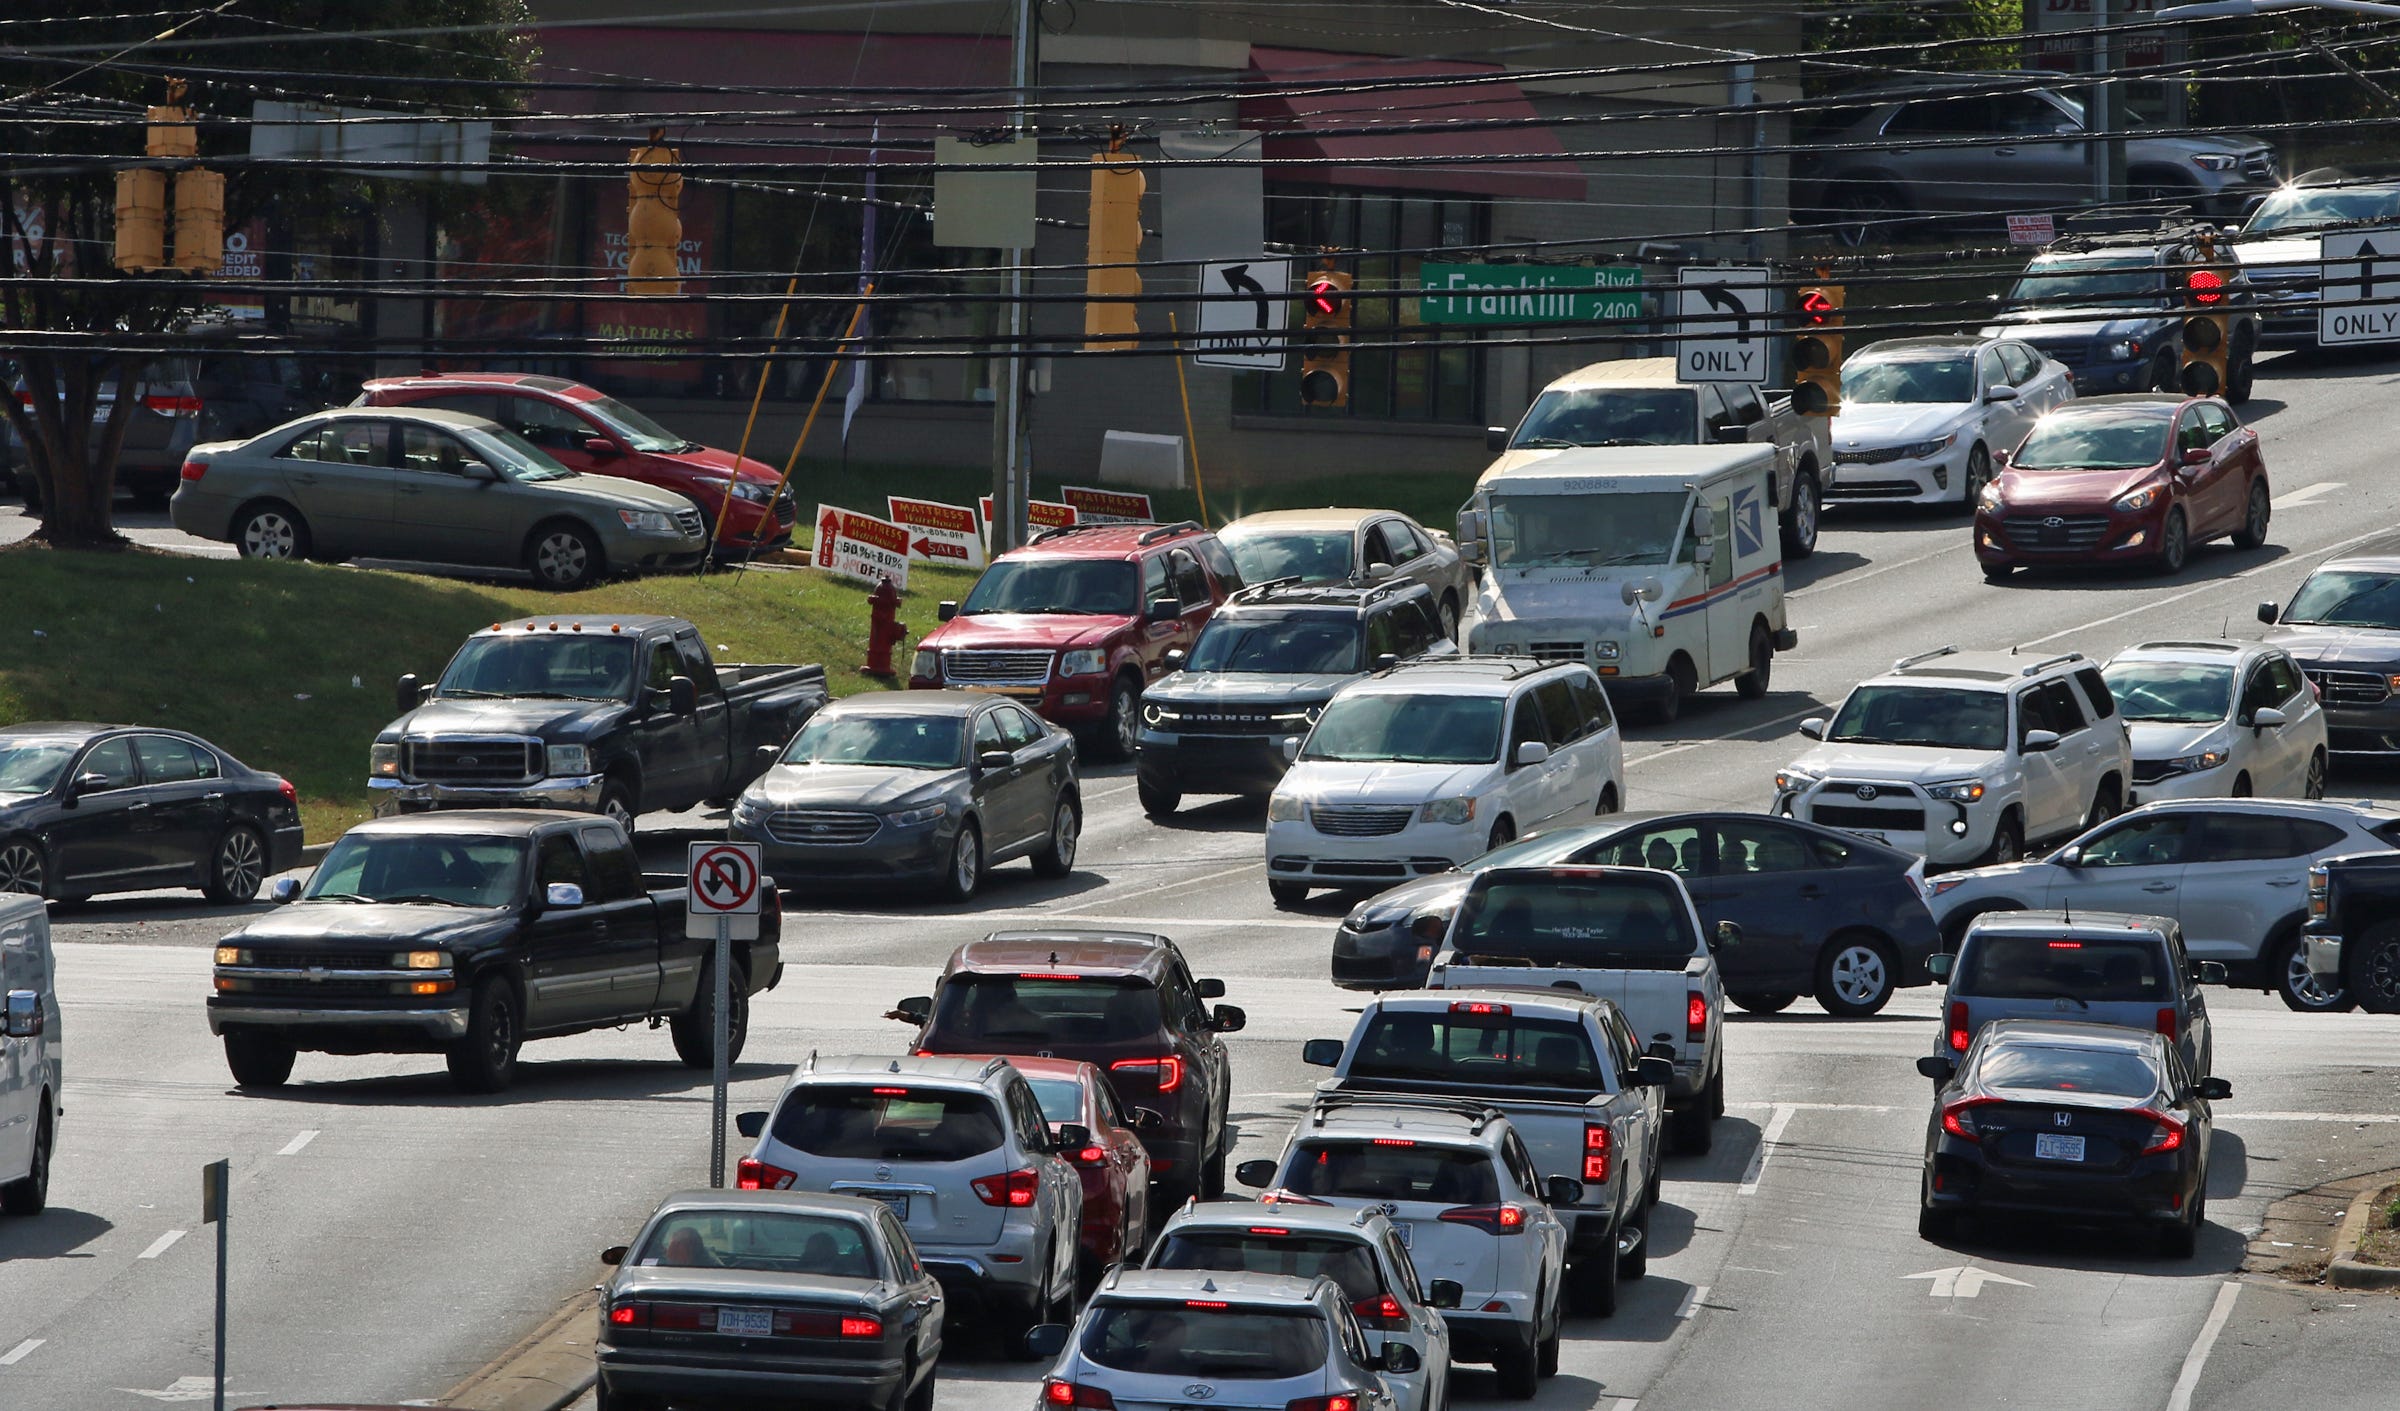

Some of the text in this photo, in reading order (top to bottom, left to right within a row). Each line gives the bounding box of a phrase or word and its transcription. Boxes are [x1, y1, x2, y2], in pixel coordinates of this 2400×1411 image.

[222, 253, 257, 265] EDIT
[1594, 272, 1635, 289] Blvd
[1426, 282, 1438, 303] E
[1447, 273, 1576, 317] Franklin
[1592, 301, 1638, 320] 2400
[598, 323, 696, 339] MATTRESS
[2334, 311, 2398, 336] ONLY
[1690, 351, 1754, 372] ONLY
[1073, 491, 1140, 507] MATTRESS
[899, 502, 965, 520] MATTRESS
[1030, 503, 1066, 518] RESS
[849, 516, 903, 541] MATTRESS
[904, 512, 963, 530] Warehouse
[949, 531, 964, 540] OFF
[822, 525, 834, 566] SALE
[927, 541, 963, 557] SALE
[1182, 713, 1267, 721] BRONCO
